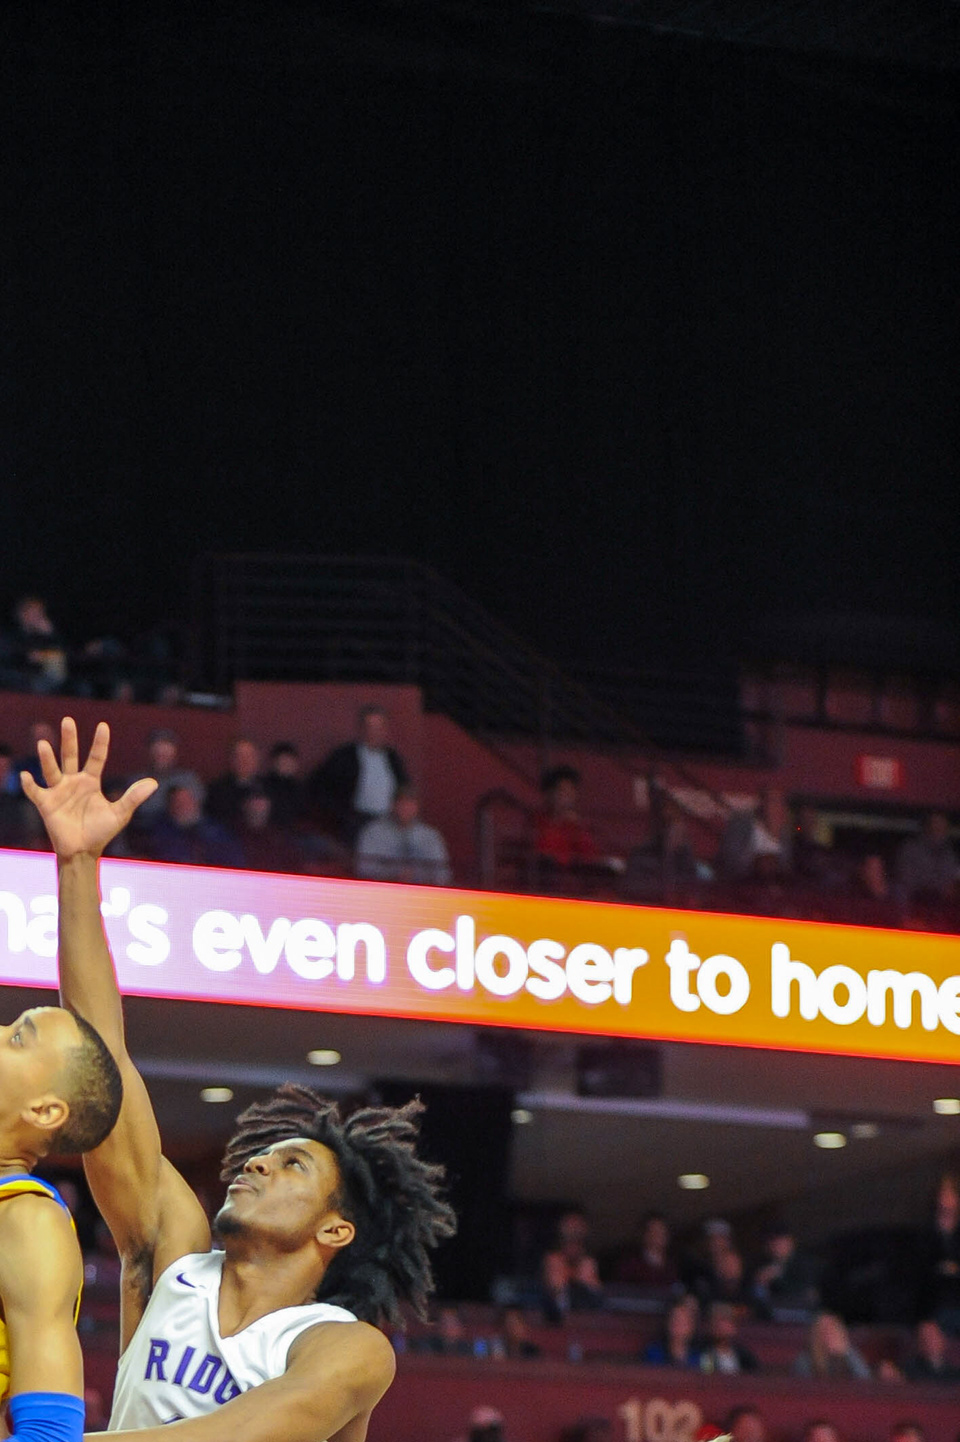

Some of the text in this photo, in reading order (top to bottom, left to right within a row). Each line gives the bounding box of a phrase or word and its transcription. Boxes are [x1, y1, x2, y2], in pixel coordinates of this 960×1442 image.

[192, 907, 386, 986] even
[406, 914, 648, 1004] closer
[665, 938, 750, 1015] to
[144, 1337, 242, 1405] RIDG
